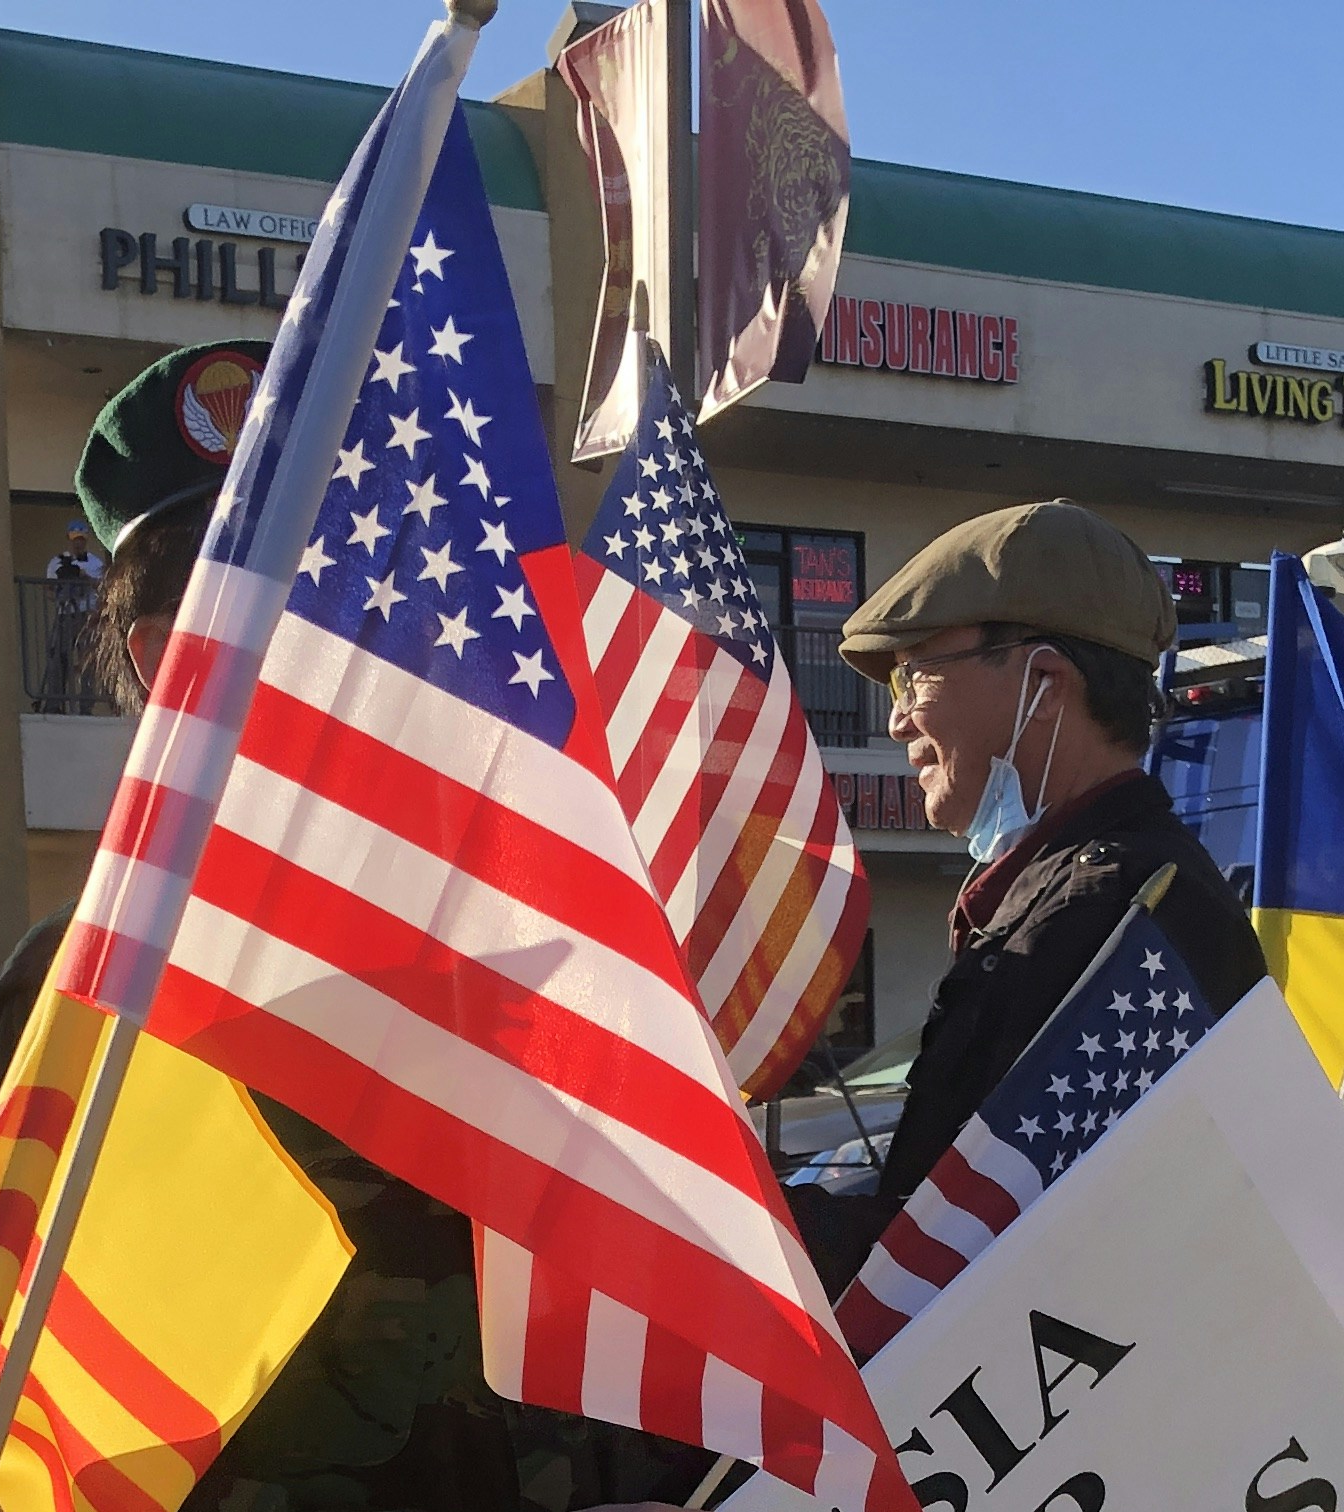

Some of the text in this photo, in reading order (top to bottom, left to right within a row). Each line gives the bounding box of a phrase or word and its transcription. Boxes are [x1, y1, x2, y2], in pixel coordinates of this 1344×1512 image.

[203, 207, 251, 230] LAW
[822, 295, 1019, 383] INSURANCE
[1266, 345, 1322, 366] LITTLE
[1212, 359, 1333, 421] LIVING
